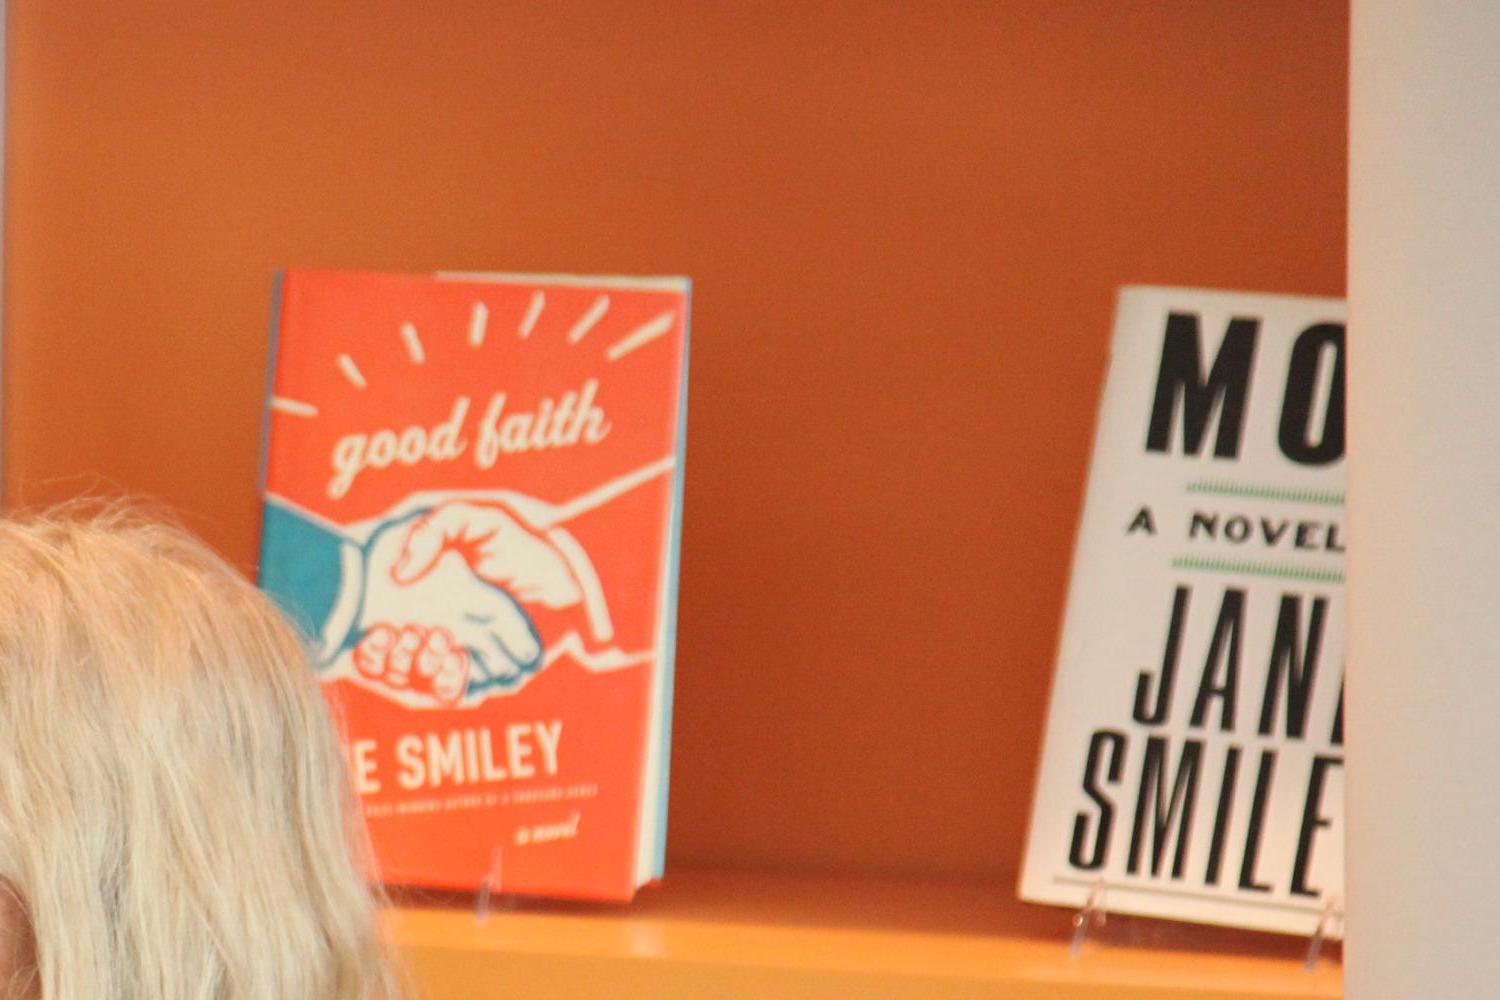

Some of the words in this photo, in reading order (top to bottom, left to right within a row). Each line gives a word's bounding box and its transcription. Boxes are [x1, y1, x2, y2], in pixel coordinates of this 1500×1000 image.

[328, 396, 468, 500] good
[474, 378, 612, 470] faith
[1126, 505, 1158, 537] A
[1188, 510, 1346, 553] NOVEL
[1131, 584, 1346, 747] JAN
[395, 720, 564, 791] SMILEY
